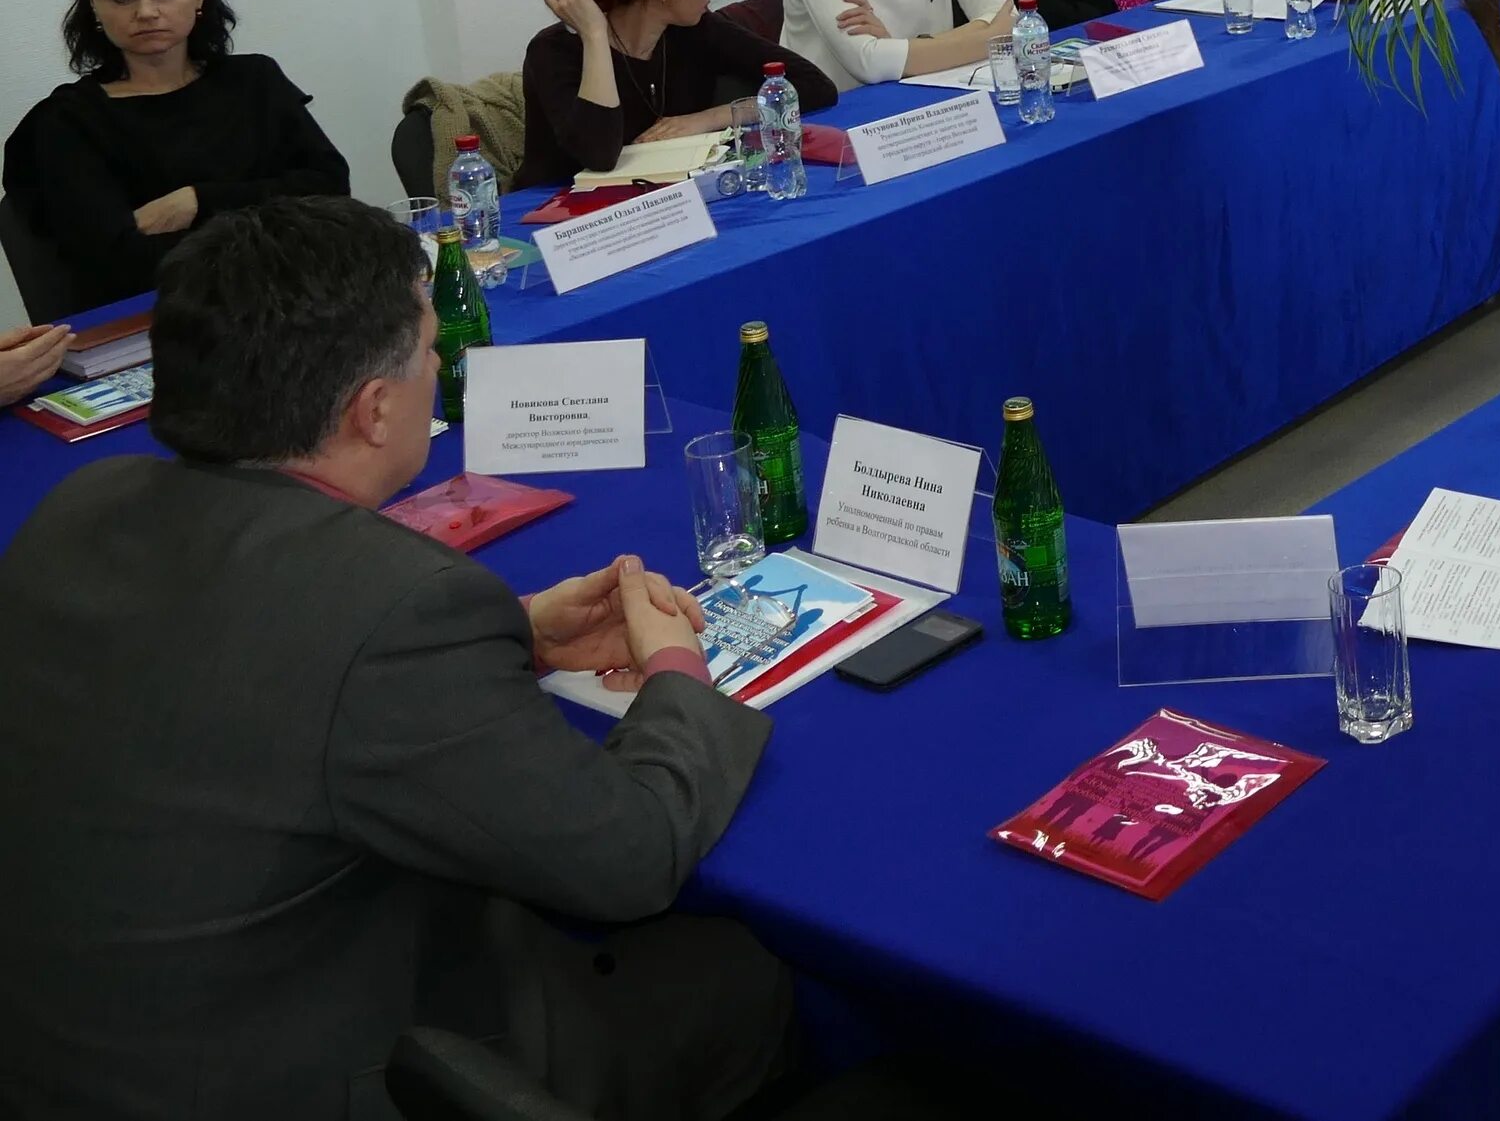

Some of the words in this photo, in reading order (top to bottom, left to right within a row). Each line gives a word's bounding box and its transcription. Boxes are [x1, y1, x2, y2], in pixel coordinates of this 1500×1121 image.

[900, 114, 925, 128] Ирина
[926, 98, 980, 118] Владимировна
[555, 216, 613, 241] Барашевская
[615, 207, 641, 220] Ольга
[643, 190, 683, 210] Павловна
[511, 398, 559, 409] Новикова
[561, 396, 609, 406] Светлана
[853, 460, 911, 486] Болдырева
[914, 476, 943, 494] Нина
[862, 485, 926, 512] Николаевна
[826, 517, 855, 531] ребенка
[862, 525, 918, 548] Волгоградской
[920, 541, 950, 557] области
[838, 501, 903, 528] Уполномоченный
[905, 521, 914, 531] по
[916, 524, 943, 539] правам
